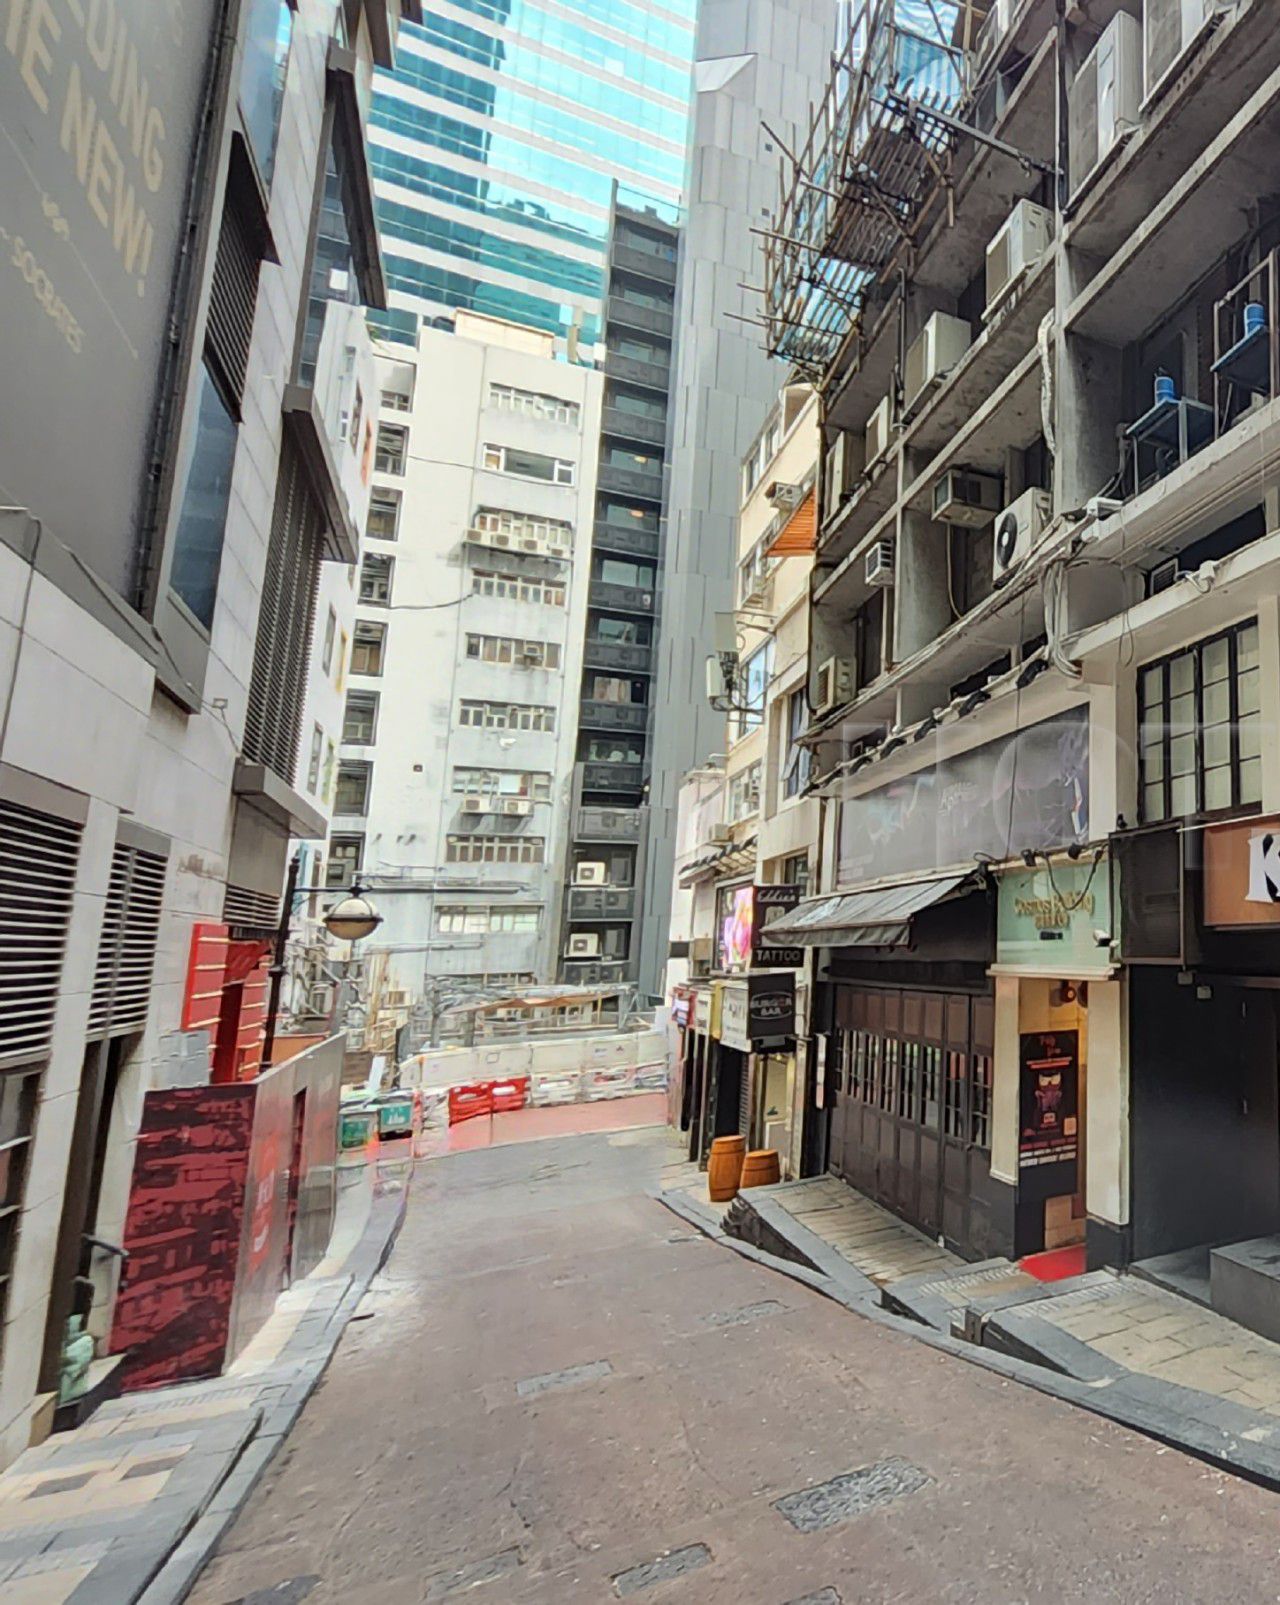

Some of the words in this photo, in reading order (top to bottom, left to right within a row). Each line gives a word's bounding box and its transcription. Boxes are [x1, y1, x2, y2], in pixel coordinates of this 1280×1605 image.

[60, 62, 152, 298] NEW!
[69, 0, 165, 192] DING
[756, 949, 801, 962] TATTOO
